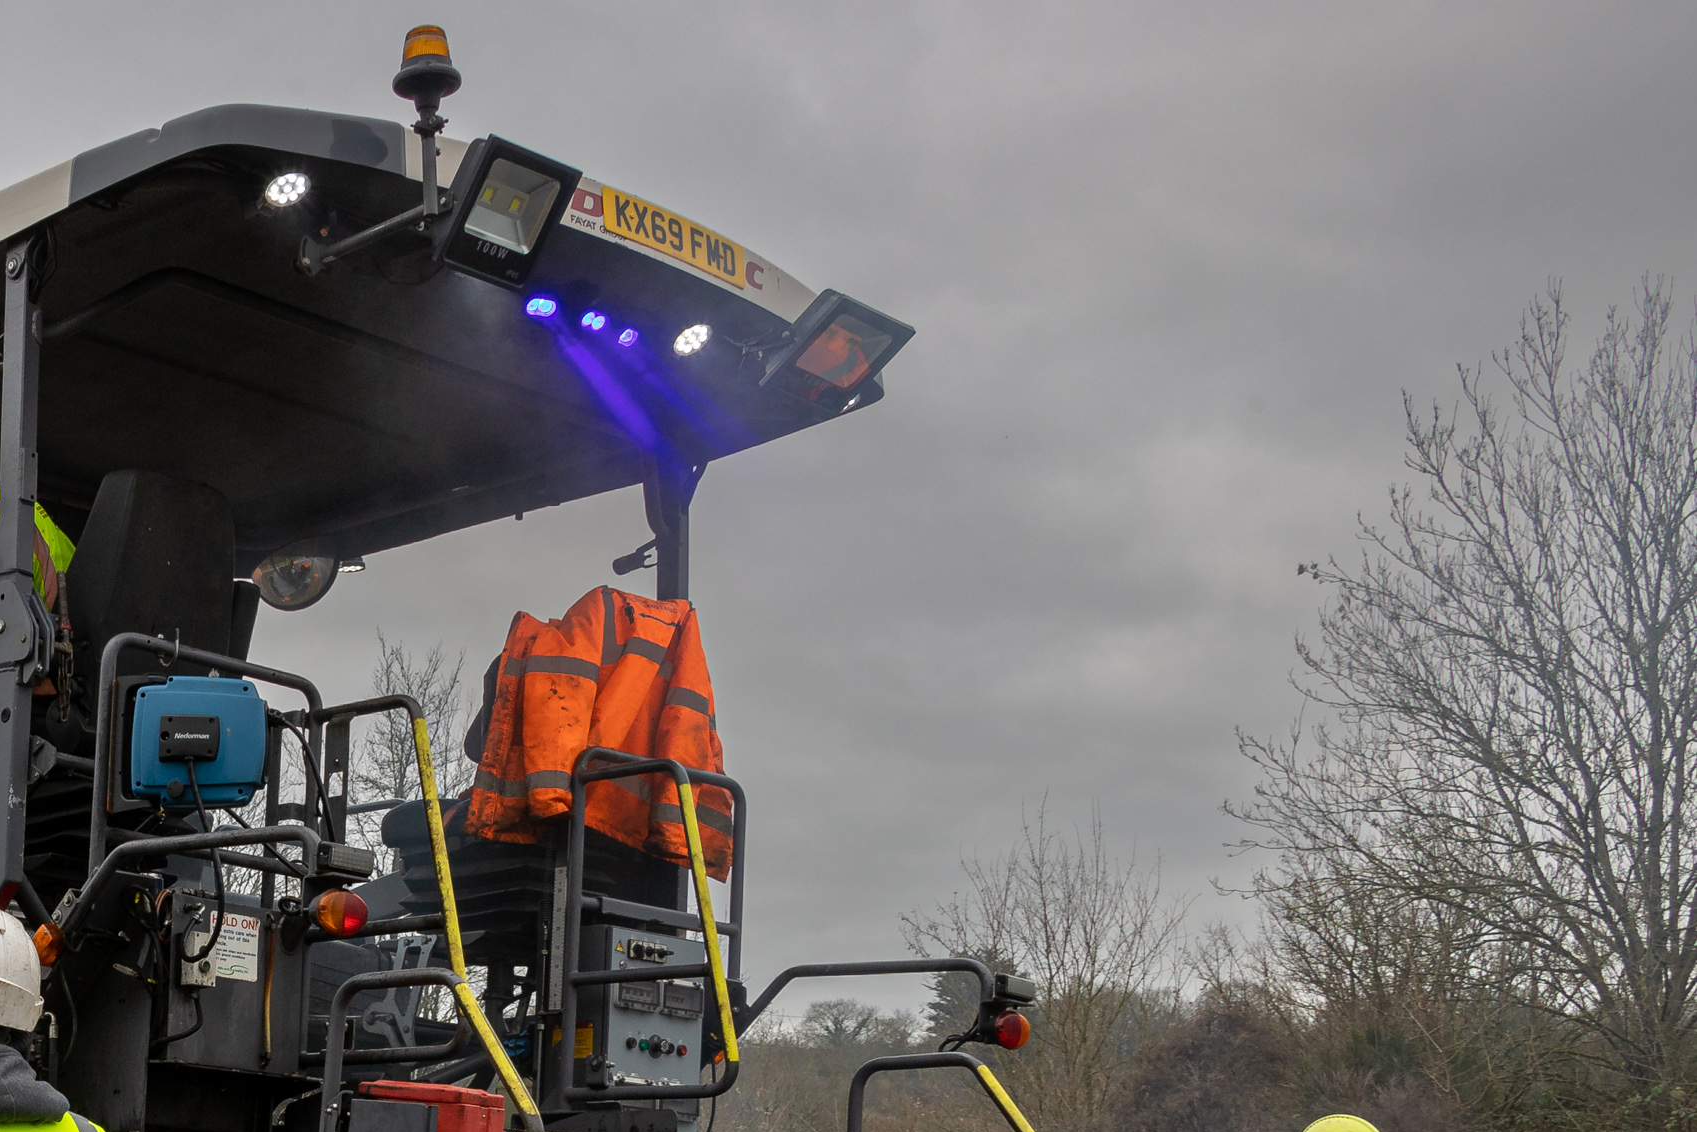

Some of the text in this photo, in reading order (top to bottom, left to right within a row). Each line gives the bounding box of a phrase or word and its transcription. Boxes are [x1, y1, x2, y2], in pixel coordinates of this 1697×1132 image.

[570, 214, 597, 231] FAYAT
[614, 194, 685, 252] KX69
[690, 226, 736, 277] FMD
[476, 240, 510, 259] 100W
[241, 919, 259, 931] ON!
